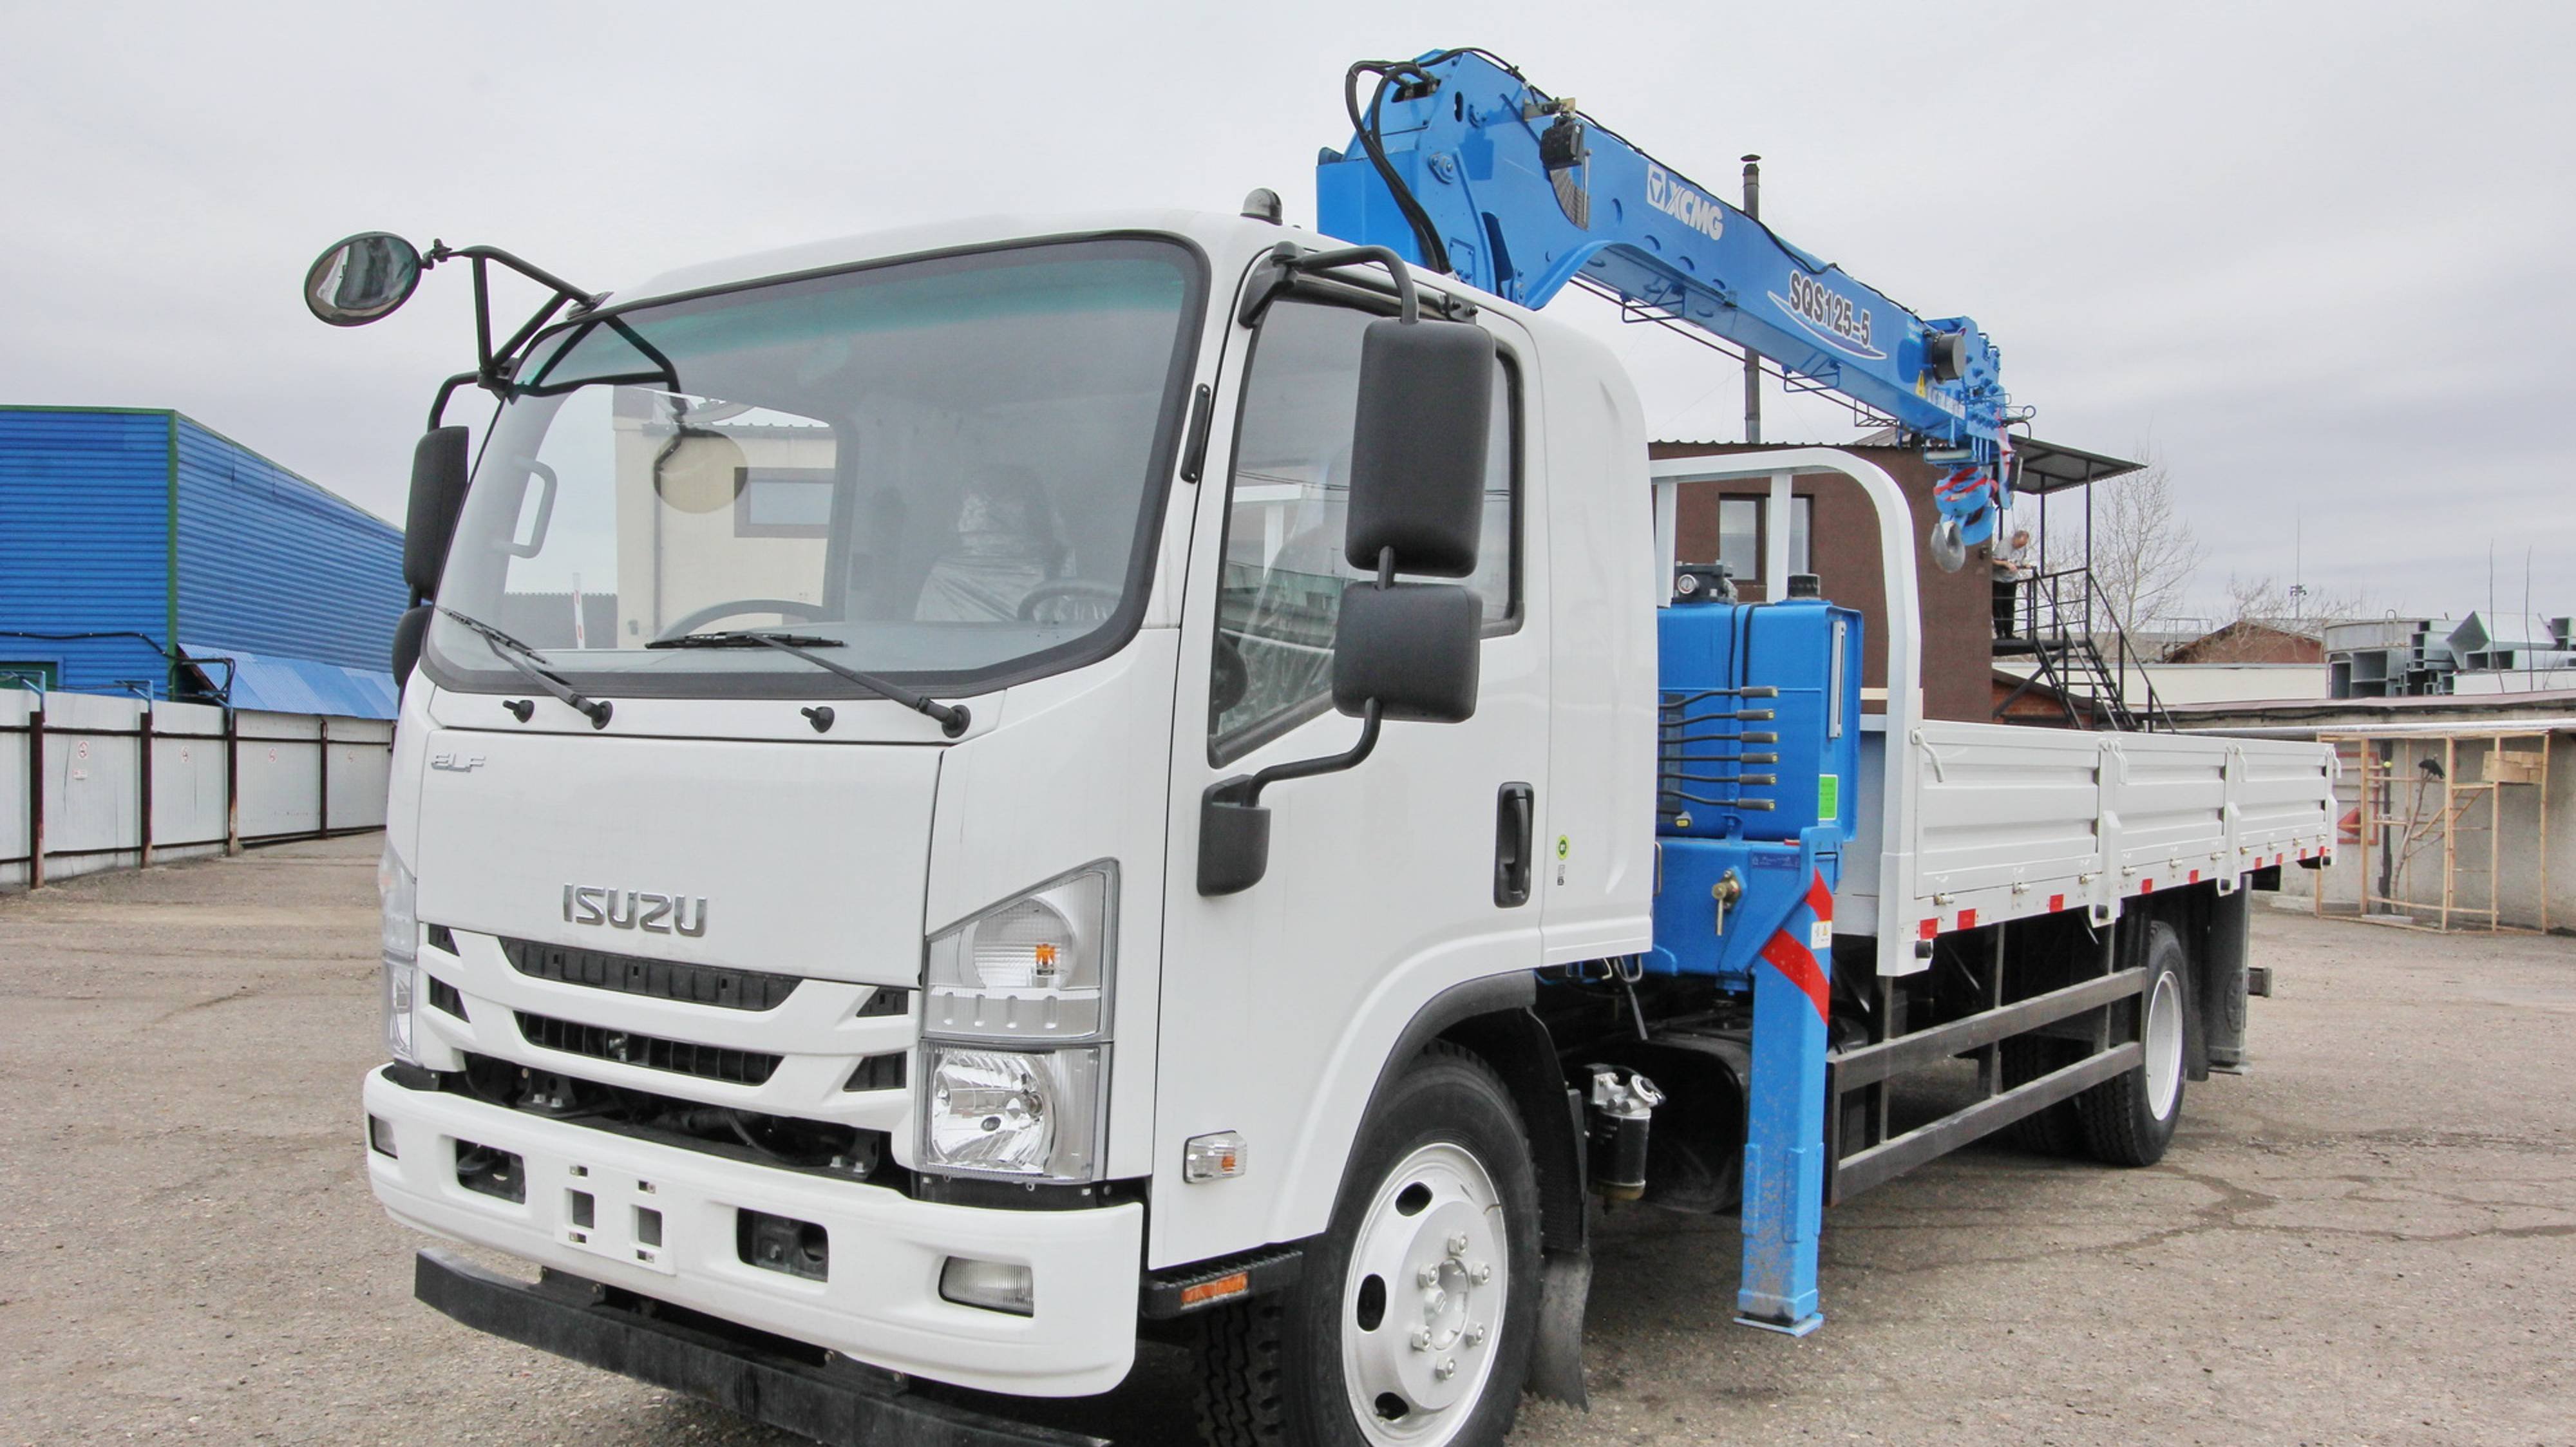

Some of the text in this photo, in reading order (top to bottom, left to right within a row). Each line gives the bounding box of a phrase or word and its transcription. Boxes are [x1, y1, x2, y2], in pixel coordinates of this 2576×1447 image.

[1664, 180, 1723, 240] XCMG
[1790, 271, 1870, 346] SQS125-5
[431, 753, 486, 773] ELF
[563, 883, 707, 937] ISUZU
